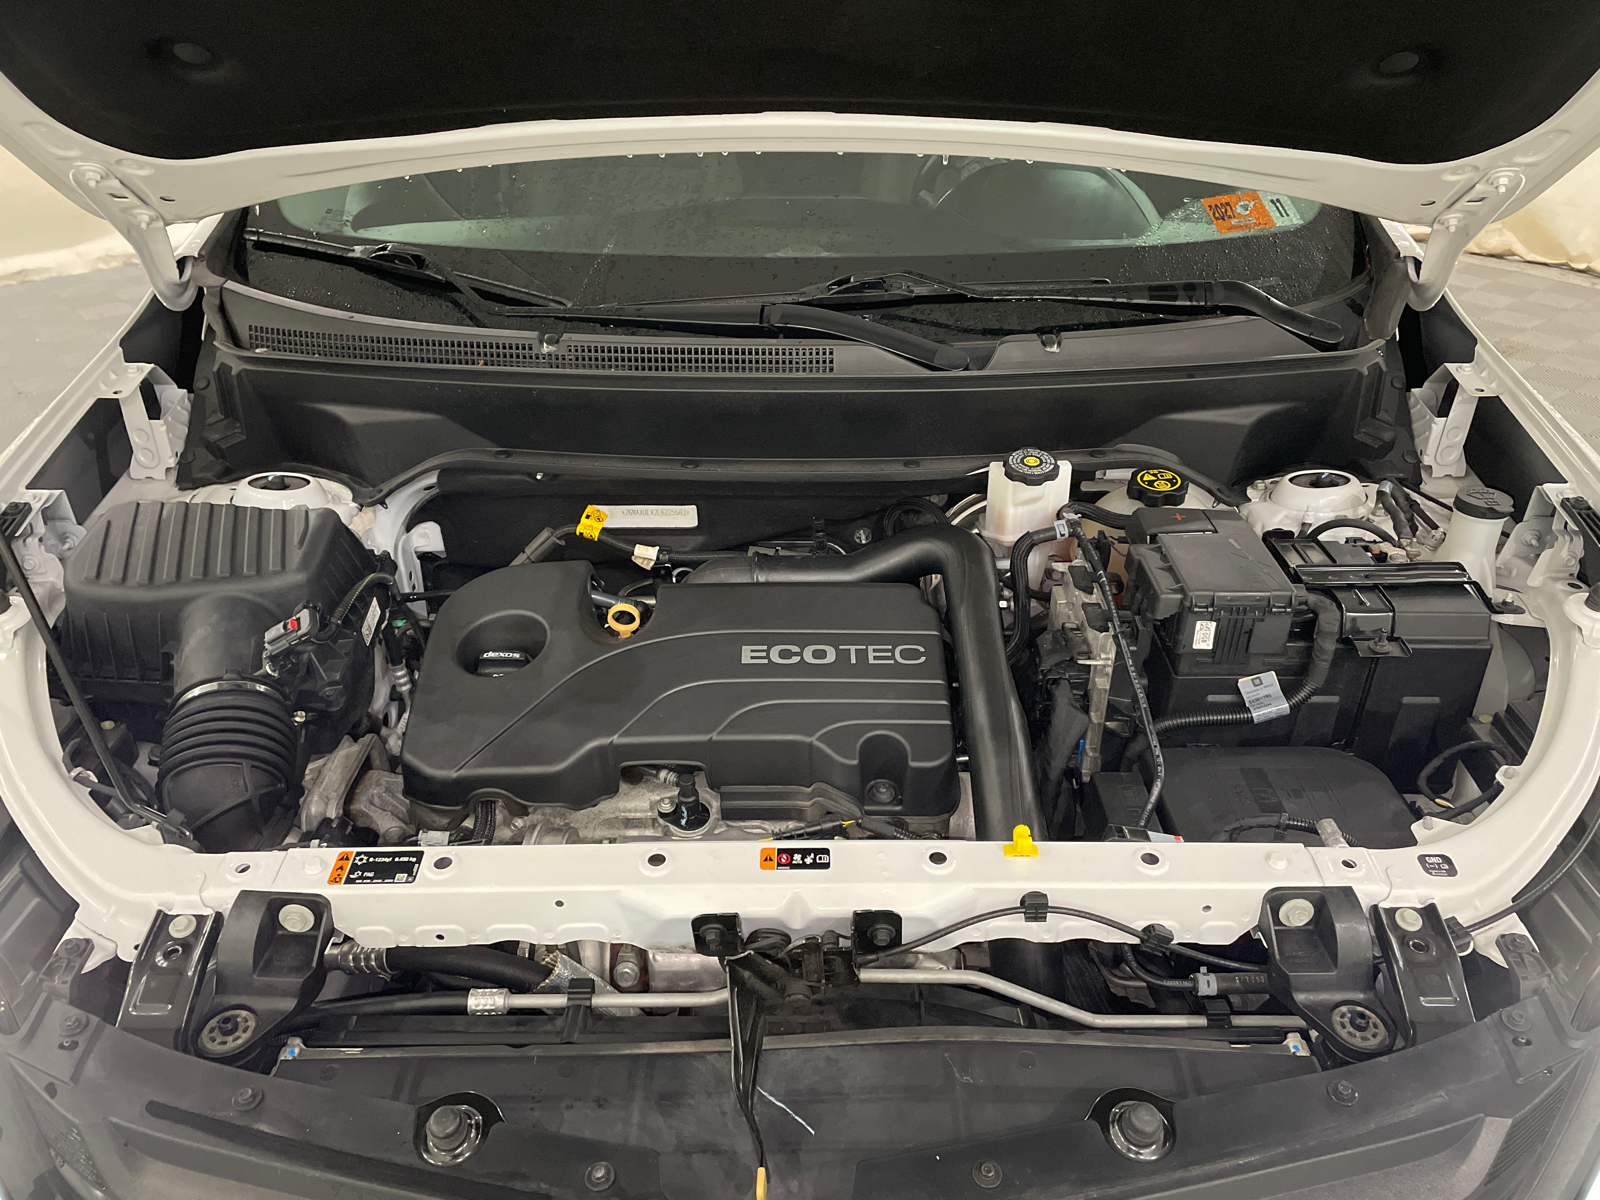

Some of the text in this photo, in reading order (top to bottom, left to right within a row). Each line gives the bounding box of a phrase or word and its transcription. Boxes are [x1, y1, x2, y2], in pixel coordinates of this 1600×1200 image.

[1208, 202, 1235, 222] 2027
[1269, 198, 1290, 217] 11
[741, 644, 926, 664] ECOTEC
